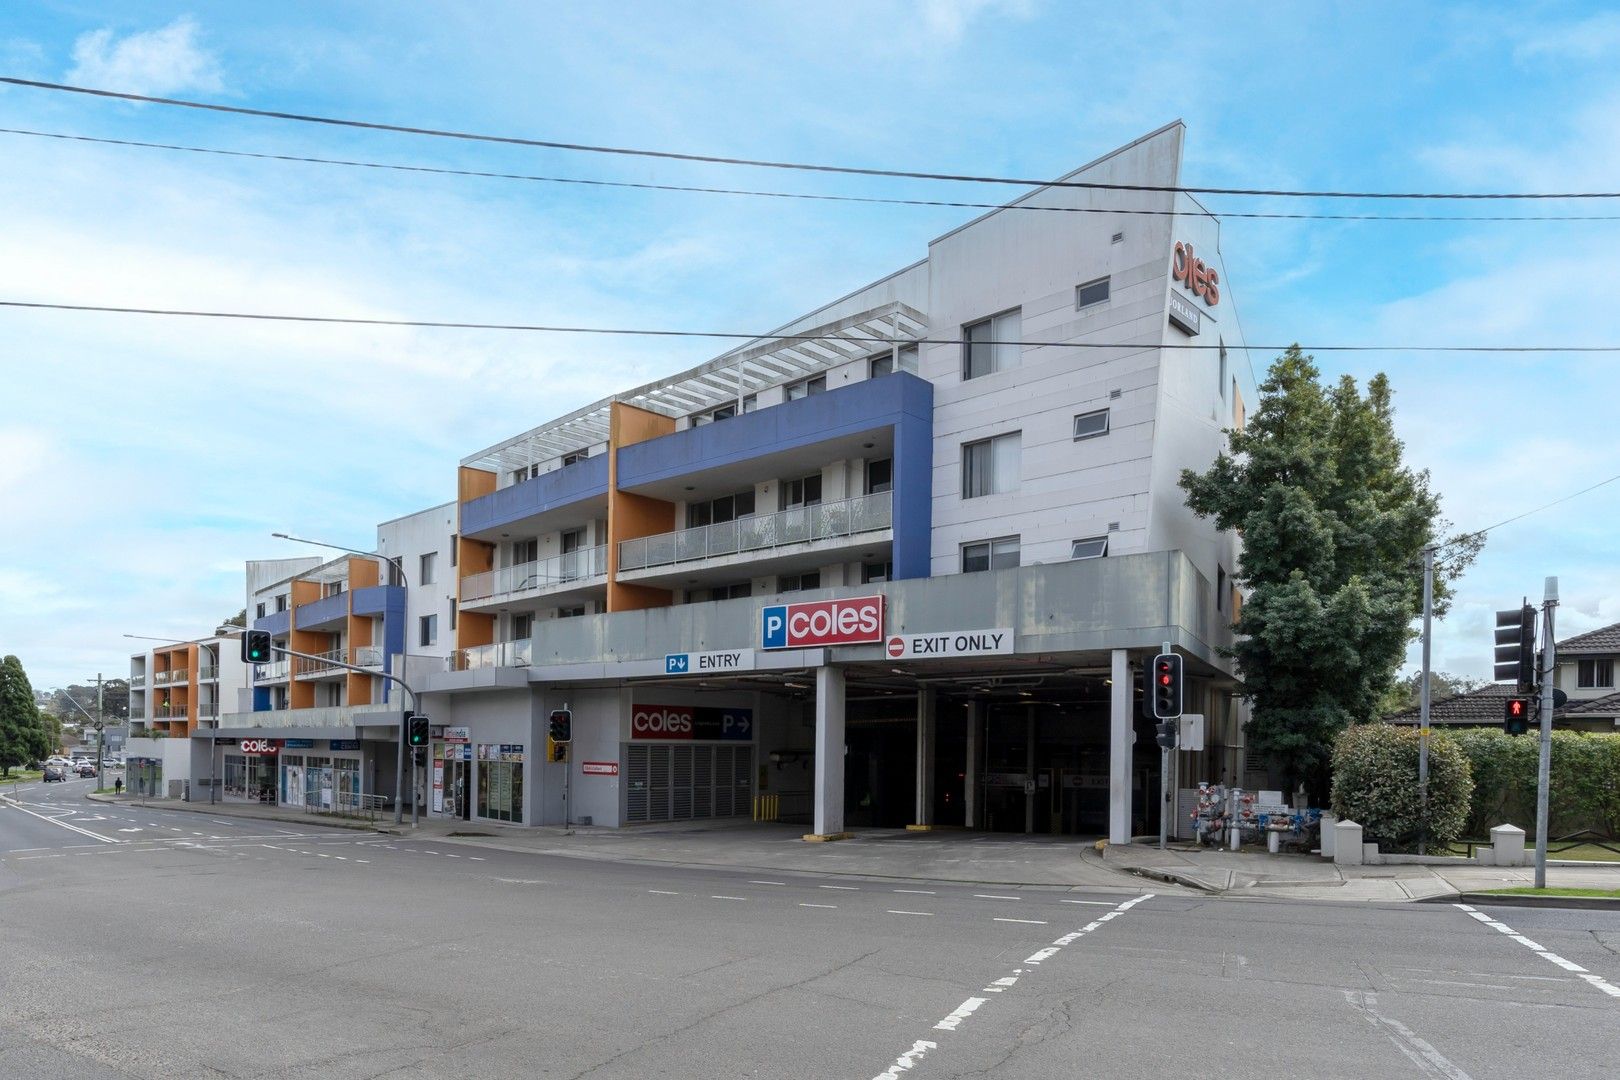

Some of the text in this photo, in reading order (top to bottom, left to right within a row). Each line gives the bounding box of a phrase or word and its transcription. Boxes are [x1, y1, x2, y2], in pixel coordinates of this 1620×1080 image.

[1173, 241, 1219, 306] oles
[1170, 297, 1198, 323] ORLAND
[767, 616, 782, 639] P
[789, 604, 878, 639] coles
[912, 633, 1004, 654] EXIT ONLY
[669, 653, 741, 671] P ENTRY
[634, 710, 692, 732] coles
[723, 714, 734, 733] P
